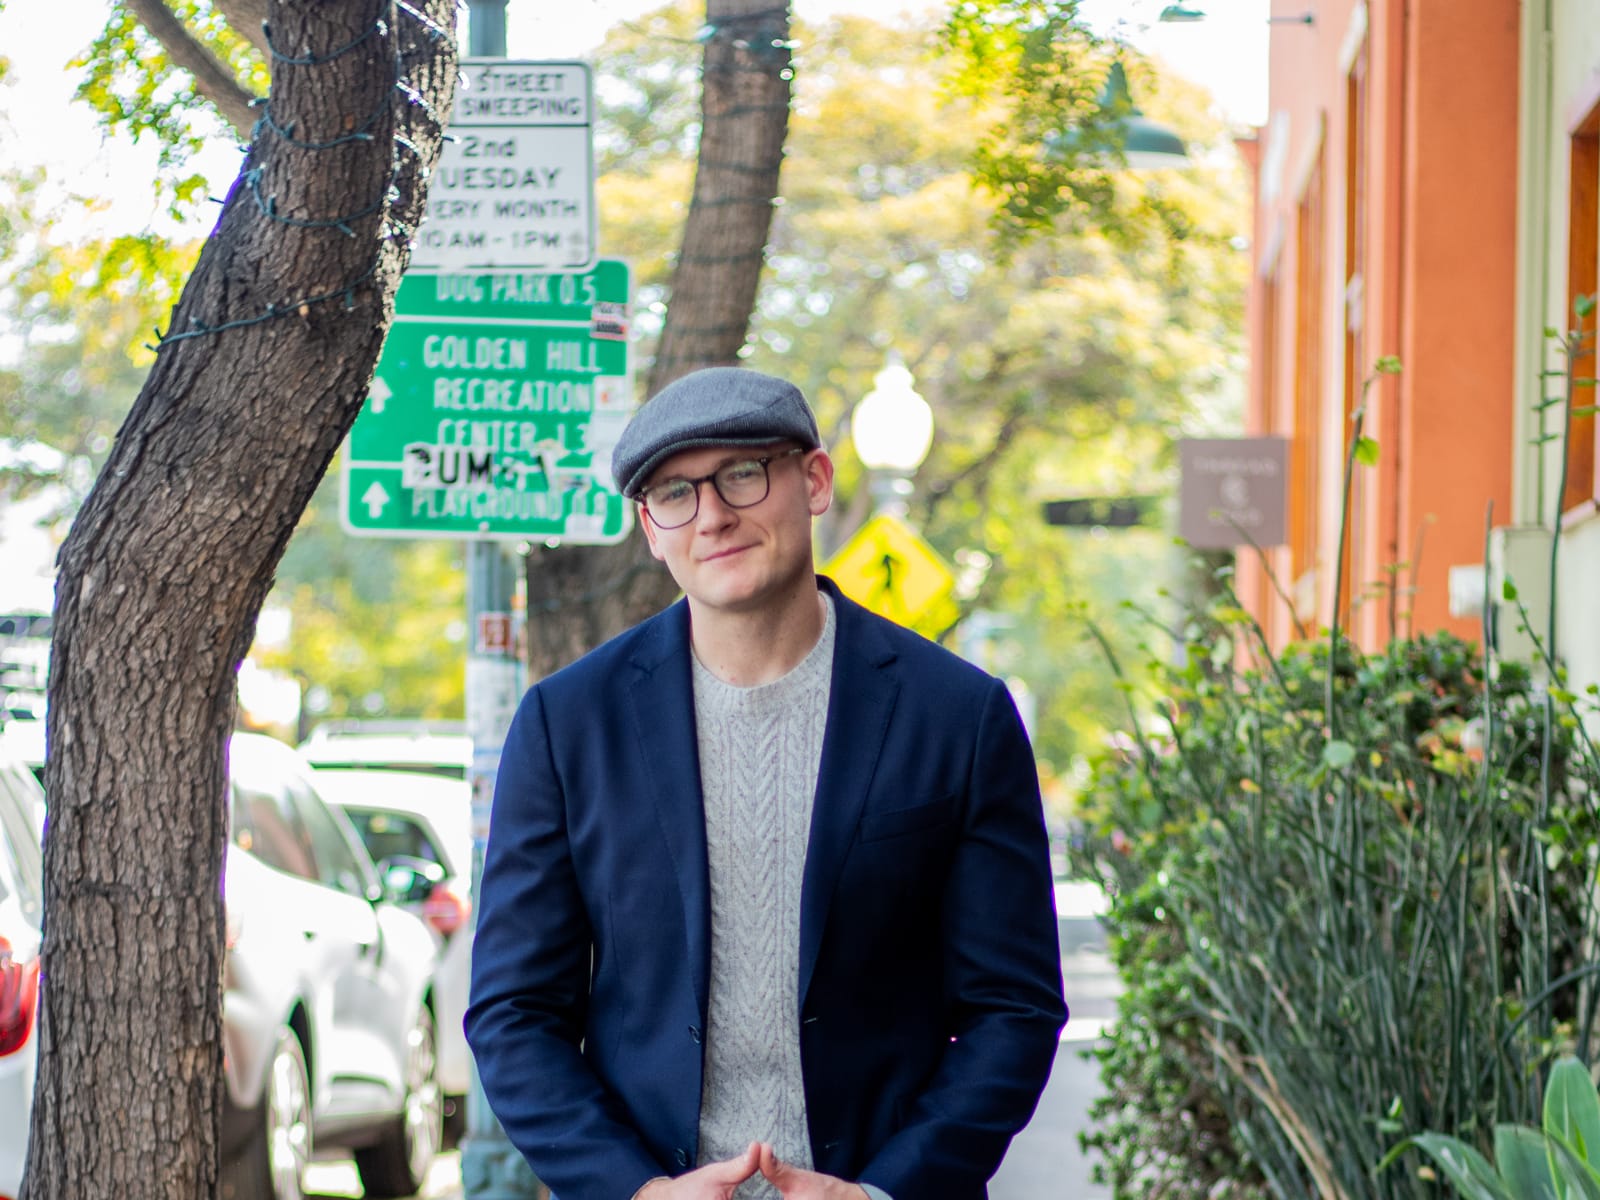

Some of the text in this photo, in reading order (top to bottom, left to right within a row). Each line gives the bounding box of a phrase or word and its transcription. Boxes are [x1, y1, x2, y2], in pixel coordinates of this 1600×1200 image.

[478, 72, 565, 92] STREET
[461, 98, 580, 116] SWEEPING
[462, 135, 516, 157] 2nd
[433, 166, 561, 190] UESDAY
[494, 199, 578, 219] MONTH
[491, 275, 550, 303] PARK
[424, 334, 604, 373] GOLDEN HILL
[434, 377, 593, 414] RECREATION
[437, 418, 537, 453] CENTER
[412, 487, 563, 521] PLAYGROUND
